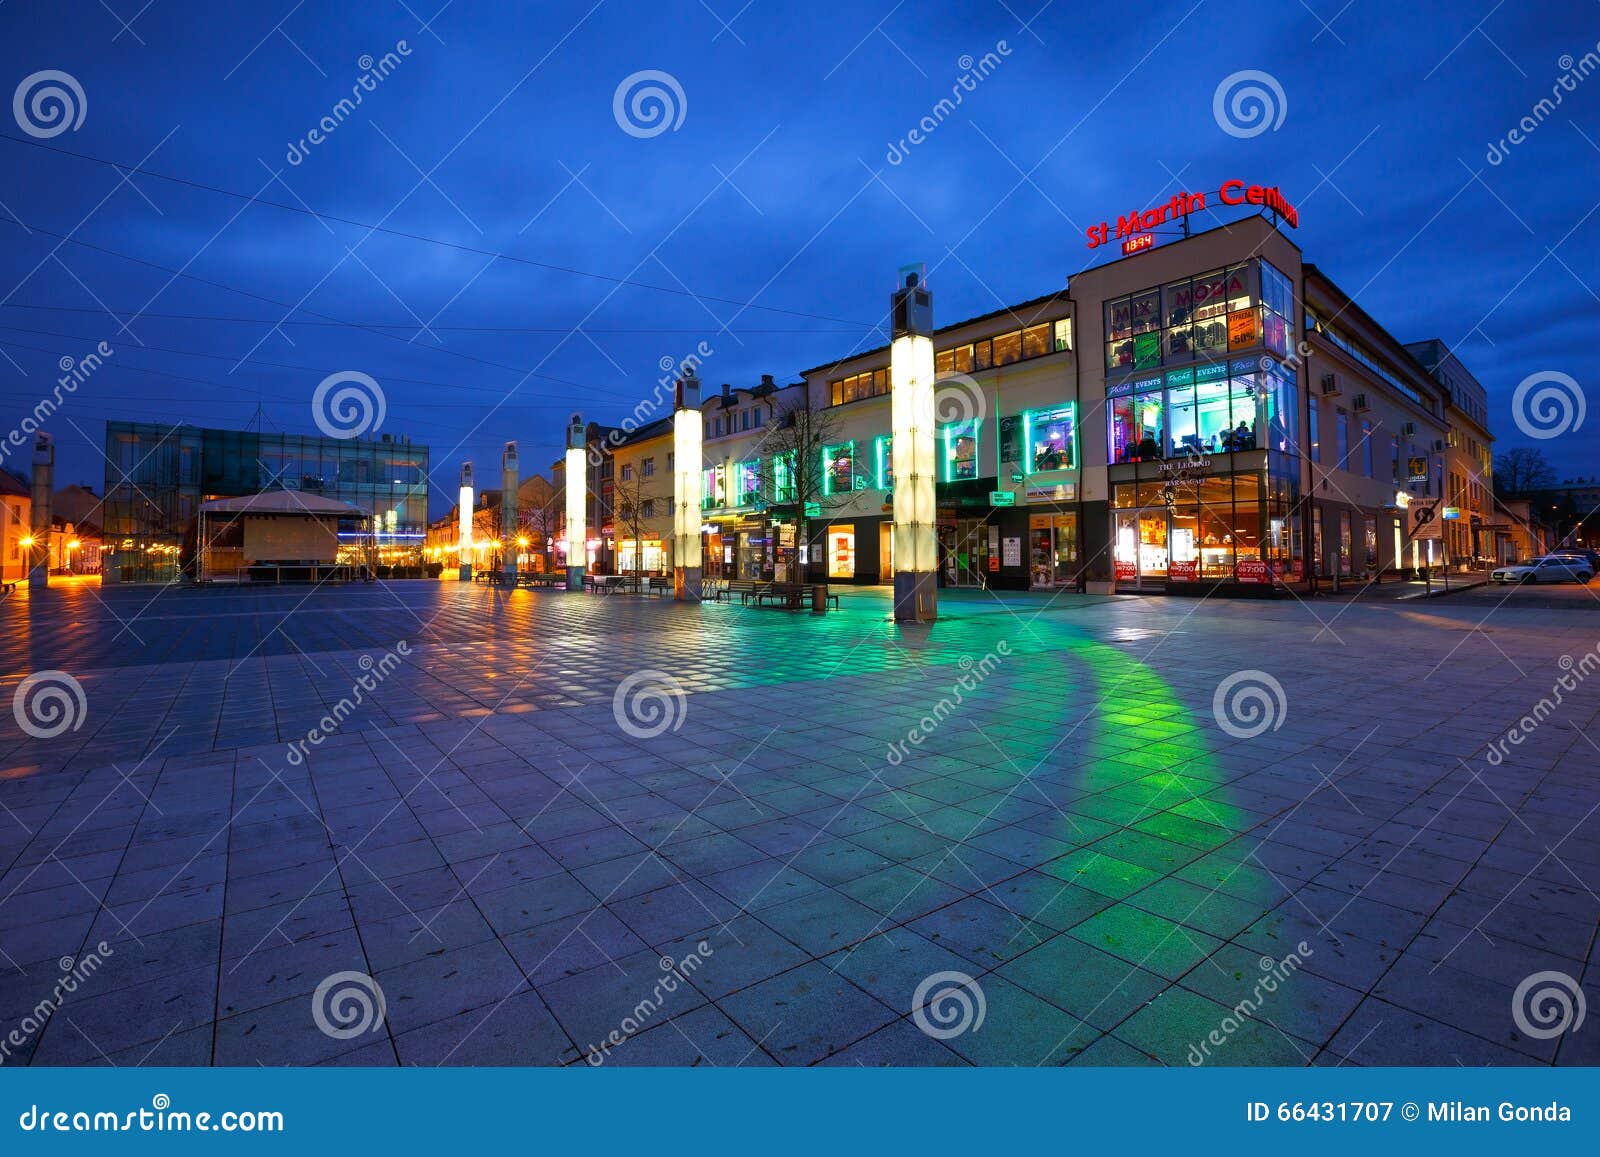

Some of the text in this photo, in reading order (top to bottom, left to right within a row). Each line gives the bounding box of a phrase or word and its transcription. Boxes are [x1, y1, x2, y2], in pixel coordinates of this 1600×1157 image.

[1086, 222, 1108, 249] St
[1115, 191, 1205, 240] Martin
[1175, 276, 1242, 306] MODA
[1135, 378, 1161, 389] EVENTS
[1197, 366, 1226, 377] EVENTS
